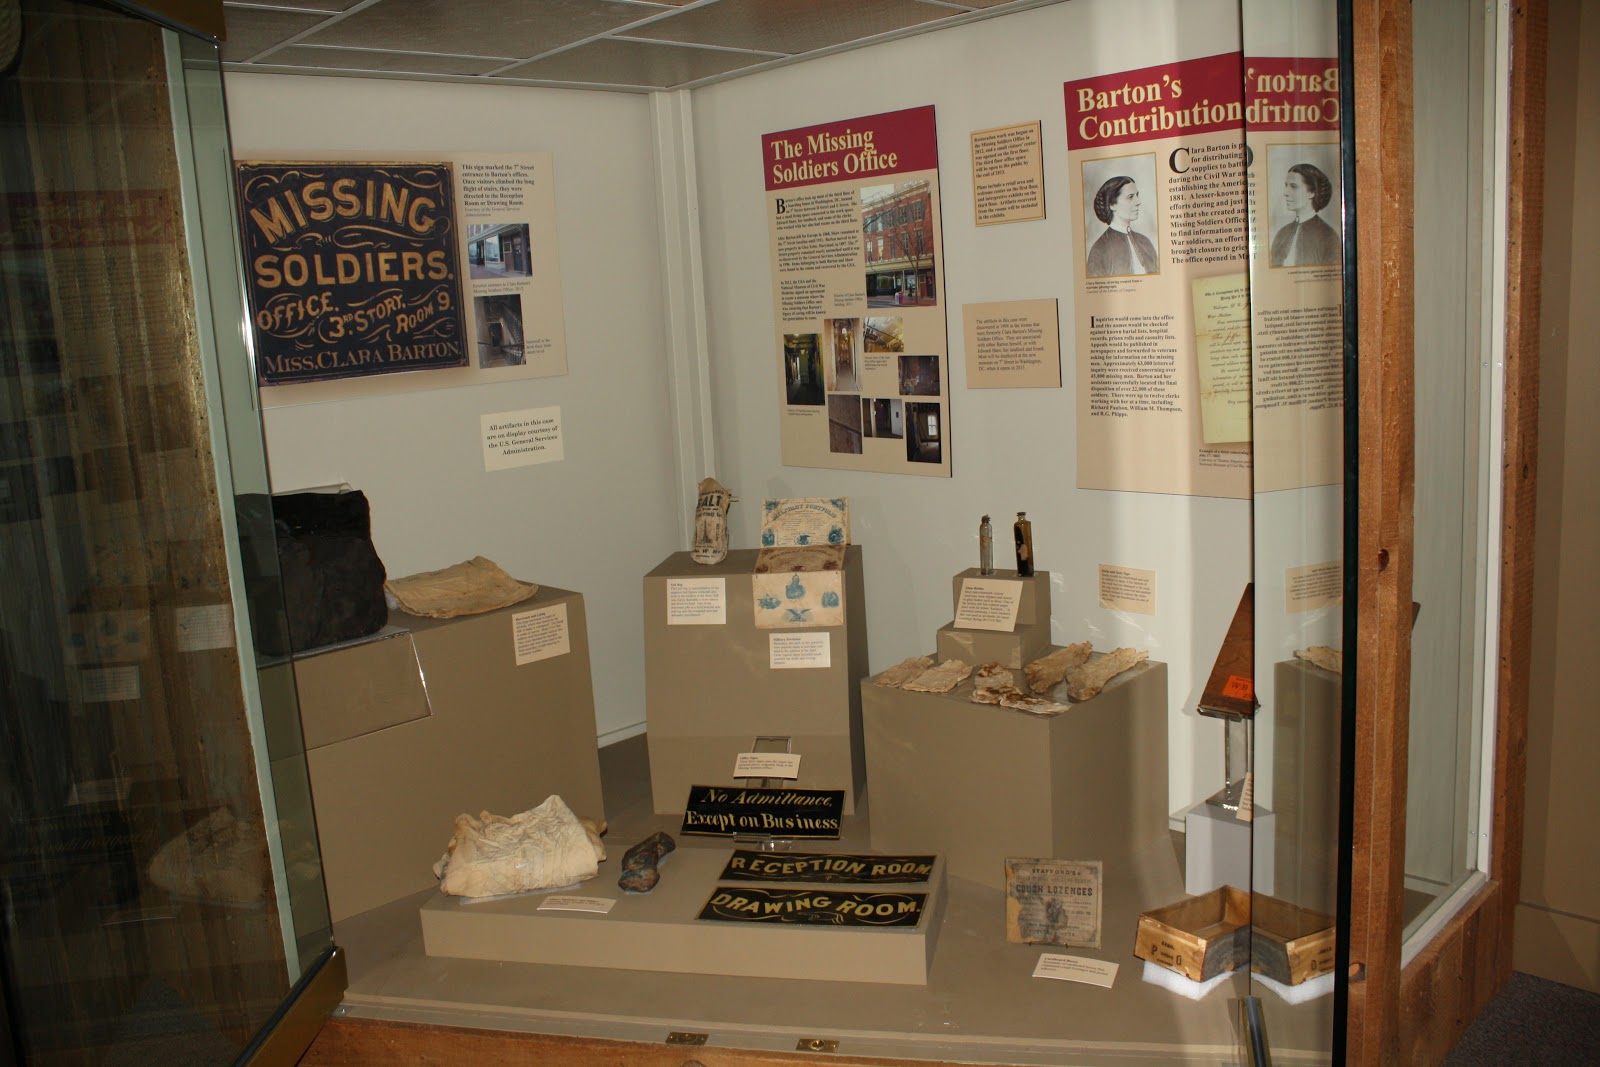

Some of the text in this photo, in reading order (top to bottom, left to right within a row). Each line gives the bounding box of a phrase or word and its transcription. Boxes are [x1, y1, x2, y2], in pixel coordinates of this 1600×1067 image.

[1077, 74, 1183, 113] Barton's
[771, 128, 875, 161] The Missing
[1203, 153, 1242, 161] distributing
[773, 151, 898, 184] Soldiers Office
[1191, 165, 1218, 173] supplies
[1169, 183, 1208, 192] establishing
[1196, 190, 1239, 199] lesser-known
[1192, 201, 1214, 209] during
[250, 178, 436, 244] MISSING
[1211, 208, 1235, 216] created
[1171, 220, 1195, 228] Missing
[1193, 227, 1232, 235] information
[1171, 247, 1197, 255] brought
[1185, 255, 1202, 263] office
[1205, 254, 1227, 263] opened
[254, 250, 454, 289] SOLDIERS.
[503, 445, 546, 455] Administration.
[702, 789, 728, 803] No
[686, 810, 736, 831] Except
[740, 815, 760, 828] on
[731, 858, 865, 875] RECEPTION
[1016, 885, 1093, 896] COUGH LOZENGES
[710, 893, 832, 913] DRAWING
